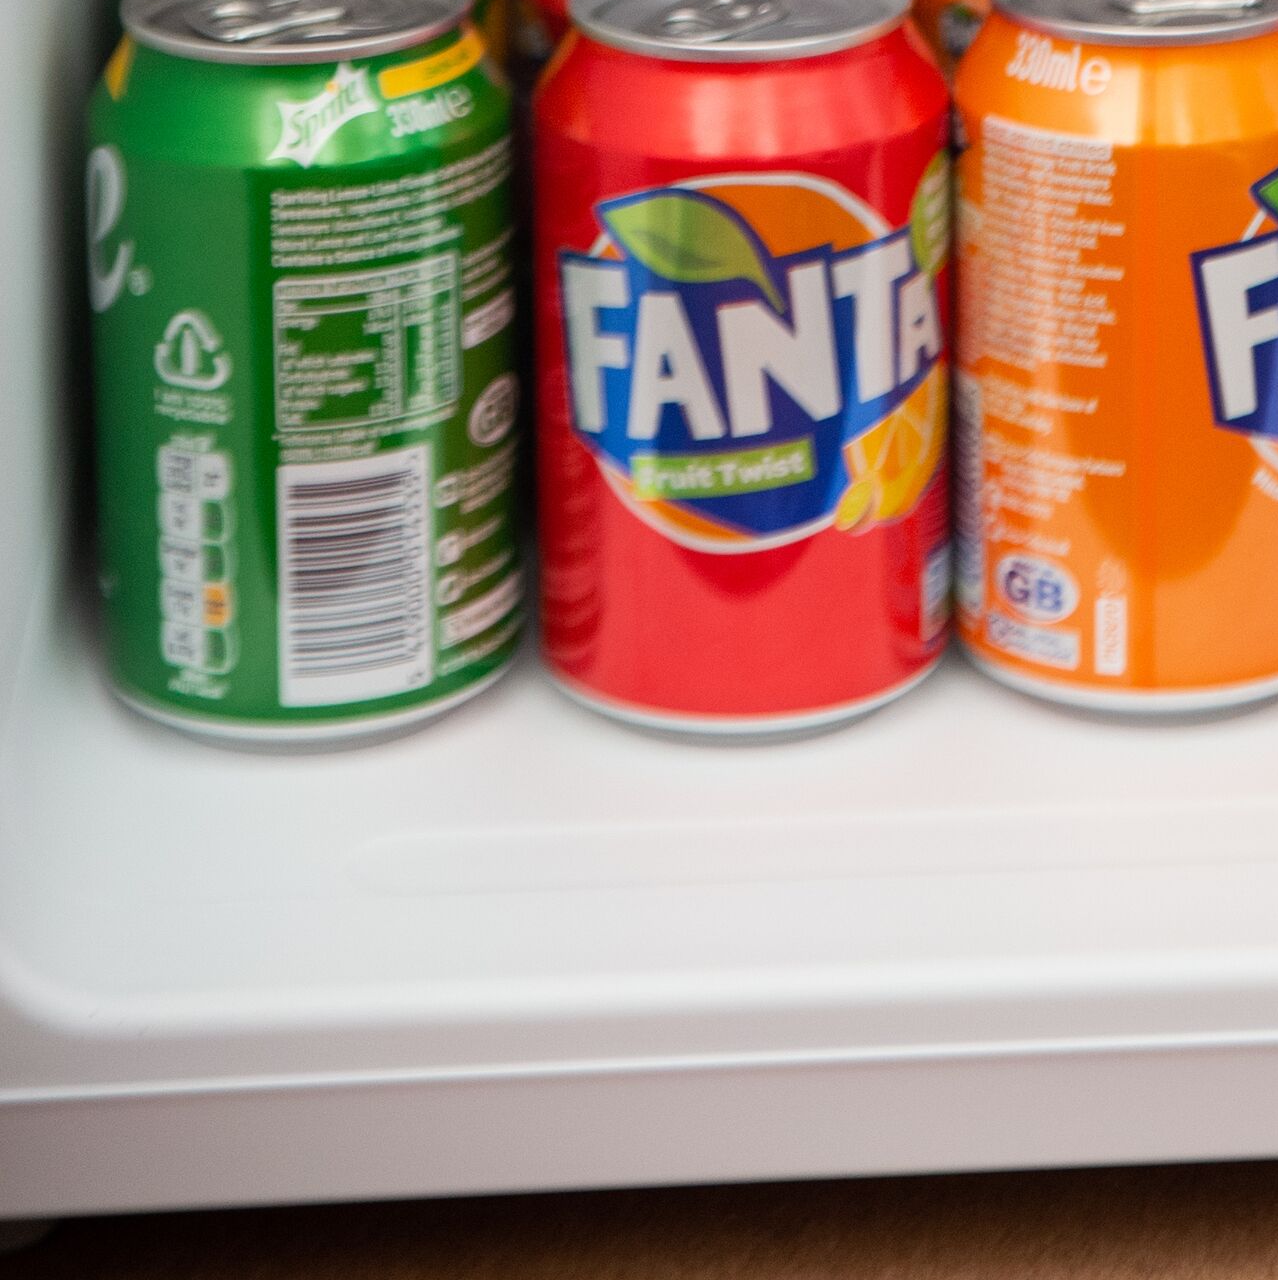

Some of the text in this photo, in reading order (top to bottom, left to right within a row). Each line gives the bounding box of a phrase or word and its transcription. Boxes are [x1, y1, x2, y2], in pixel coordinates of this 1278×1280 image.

[562, 236, 944, 442] FANTA
[636, 449, 809, 494] Fruit Twist
